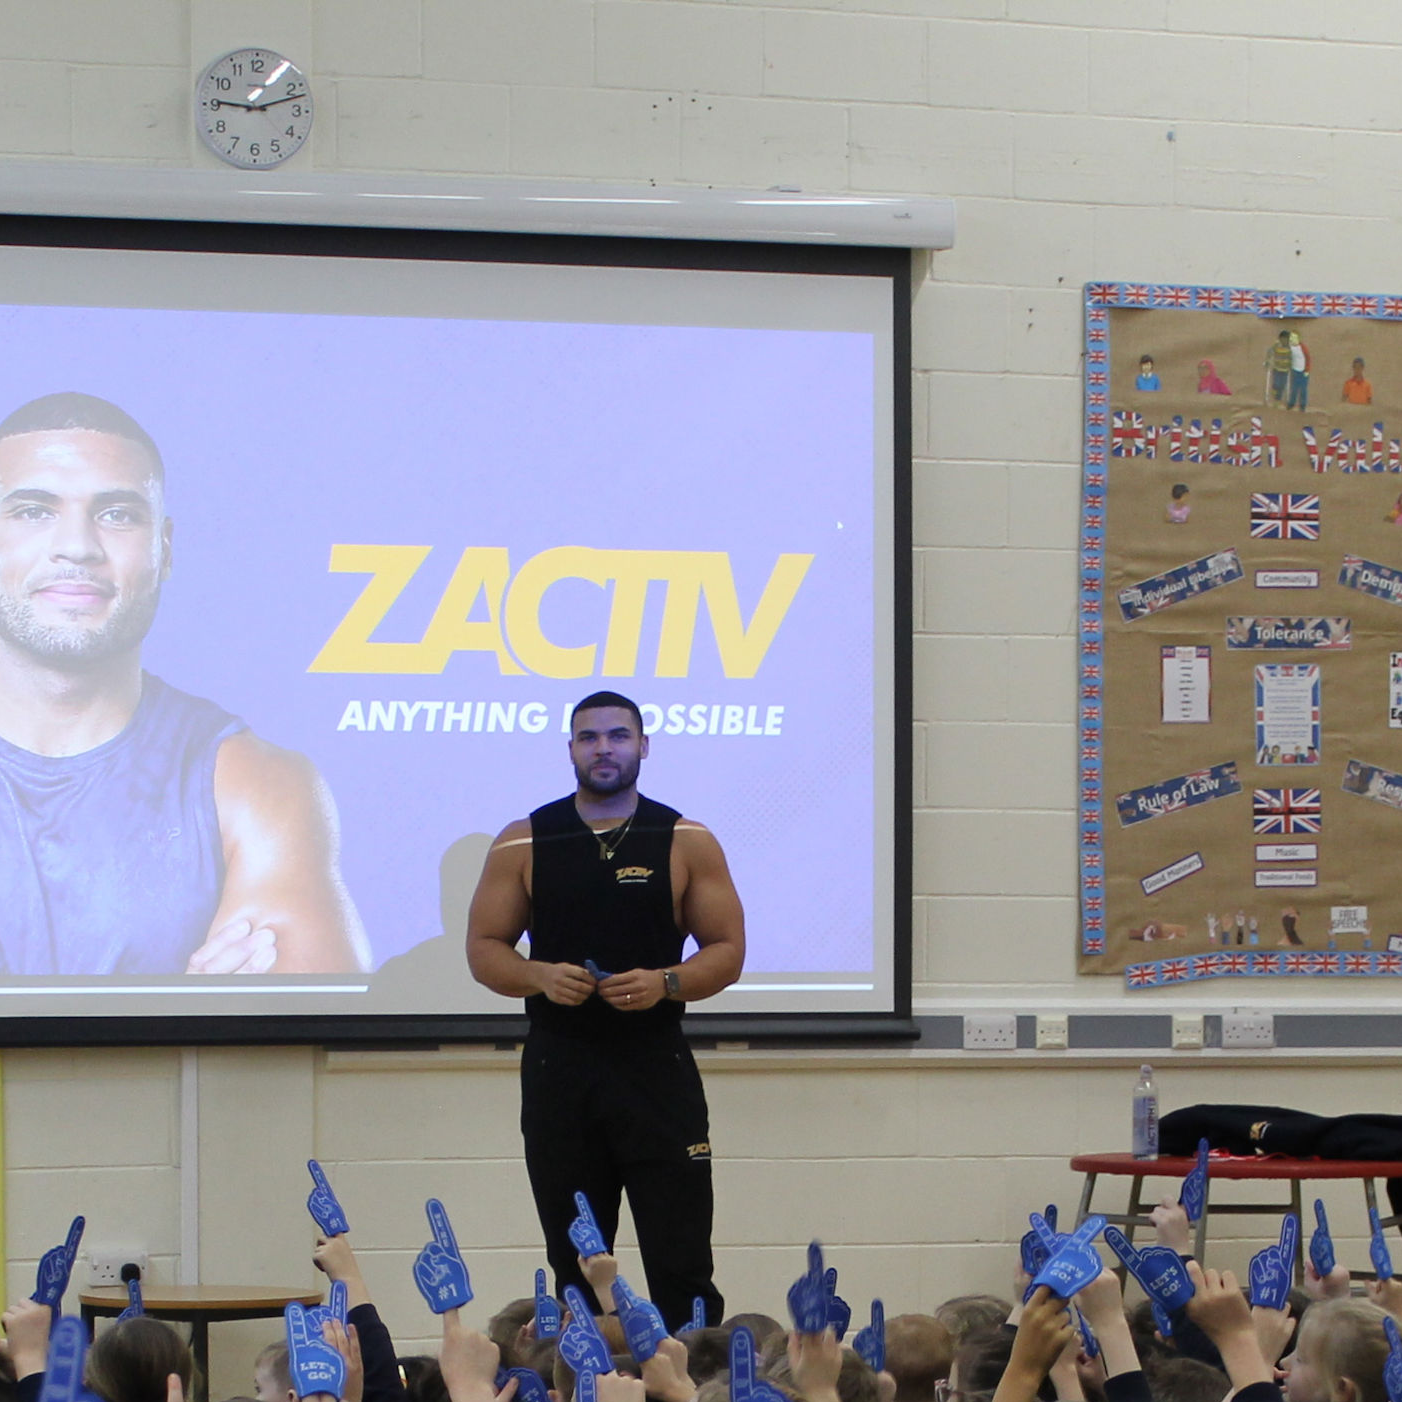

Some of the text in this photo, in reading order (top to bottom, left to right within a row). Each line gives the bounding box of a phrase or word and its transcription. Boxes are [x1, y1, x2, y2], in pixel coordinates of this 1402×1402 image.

[233, 63, 243, 76] 11
[251, 60, 264, 73] 12
[216, 78, 231, 90] 10
[286, 83, 296, 96] 2
[211, 98, 220, 111] 9
[292, 104, 301, 117] 3
[216, 120, 226, 133] 8
[286, 125, 295, 138] 4
[231, 136, 240, 149] 7
[270, 139, 280, 153] 5
[250, 143, 260, 156] 6
[1112, 411, 1283, 468] British
[306, 543, 815, 679] ZACTIV
[1255, 626, 1324, 642] Tolerance
[337, 701, 548, 734] ANYTHING
[642, 704, 784, 735] OSSIBLE
[1138, 779, 1219, 811] Rule of Law
[330, 1218, 342, 1229] #1
[1053, 1260, 1084, 1279] LET'S
[1050, 1270, 1072, 1284] GO!
[1150, 1266, 1179, 1290] LET'S
[438, 1283, 457, 1300] #1
[1162, 1280, 1182, 1298] GO!
[1260, 1286, 1278, 1302] #1
[300, 1361, 336, 1374] LET'S
[308, 1372, 331, 1381] GO!
